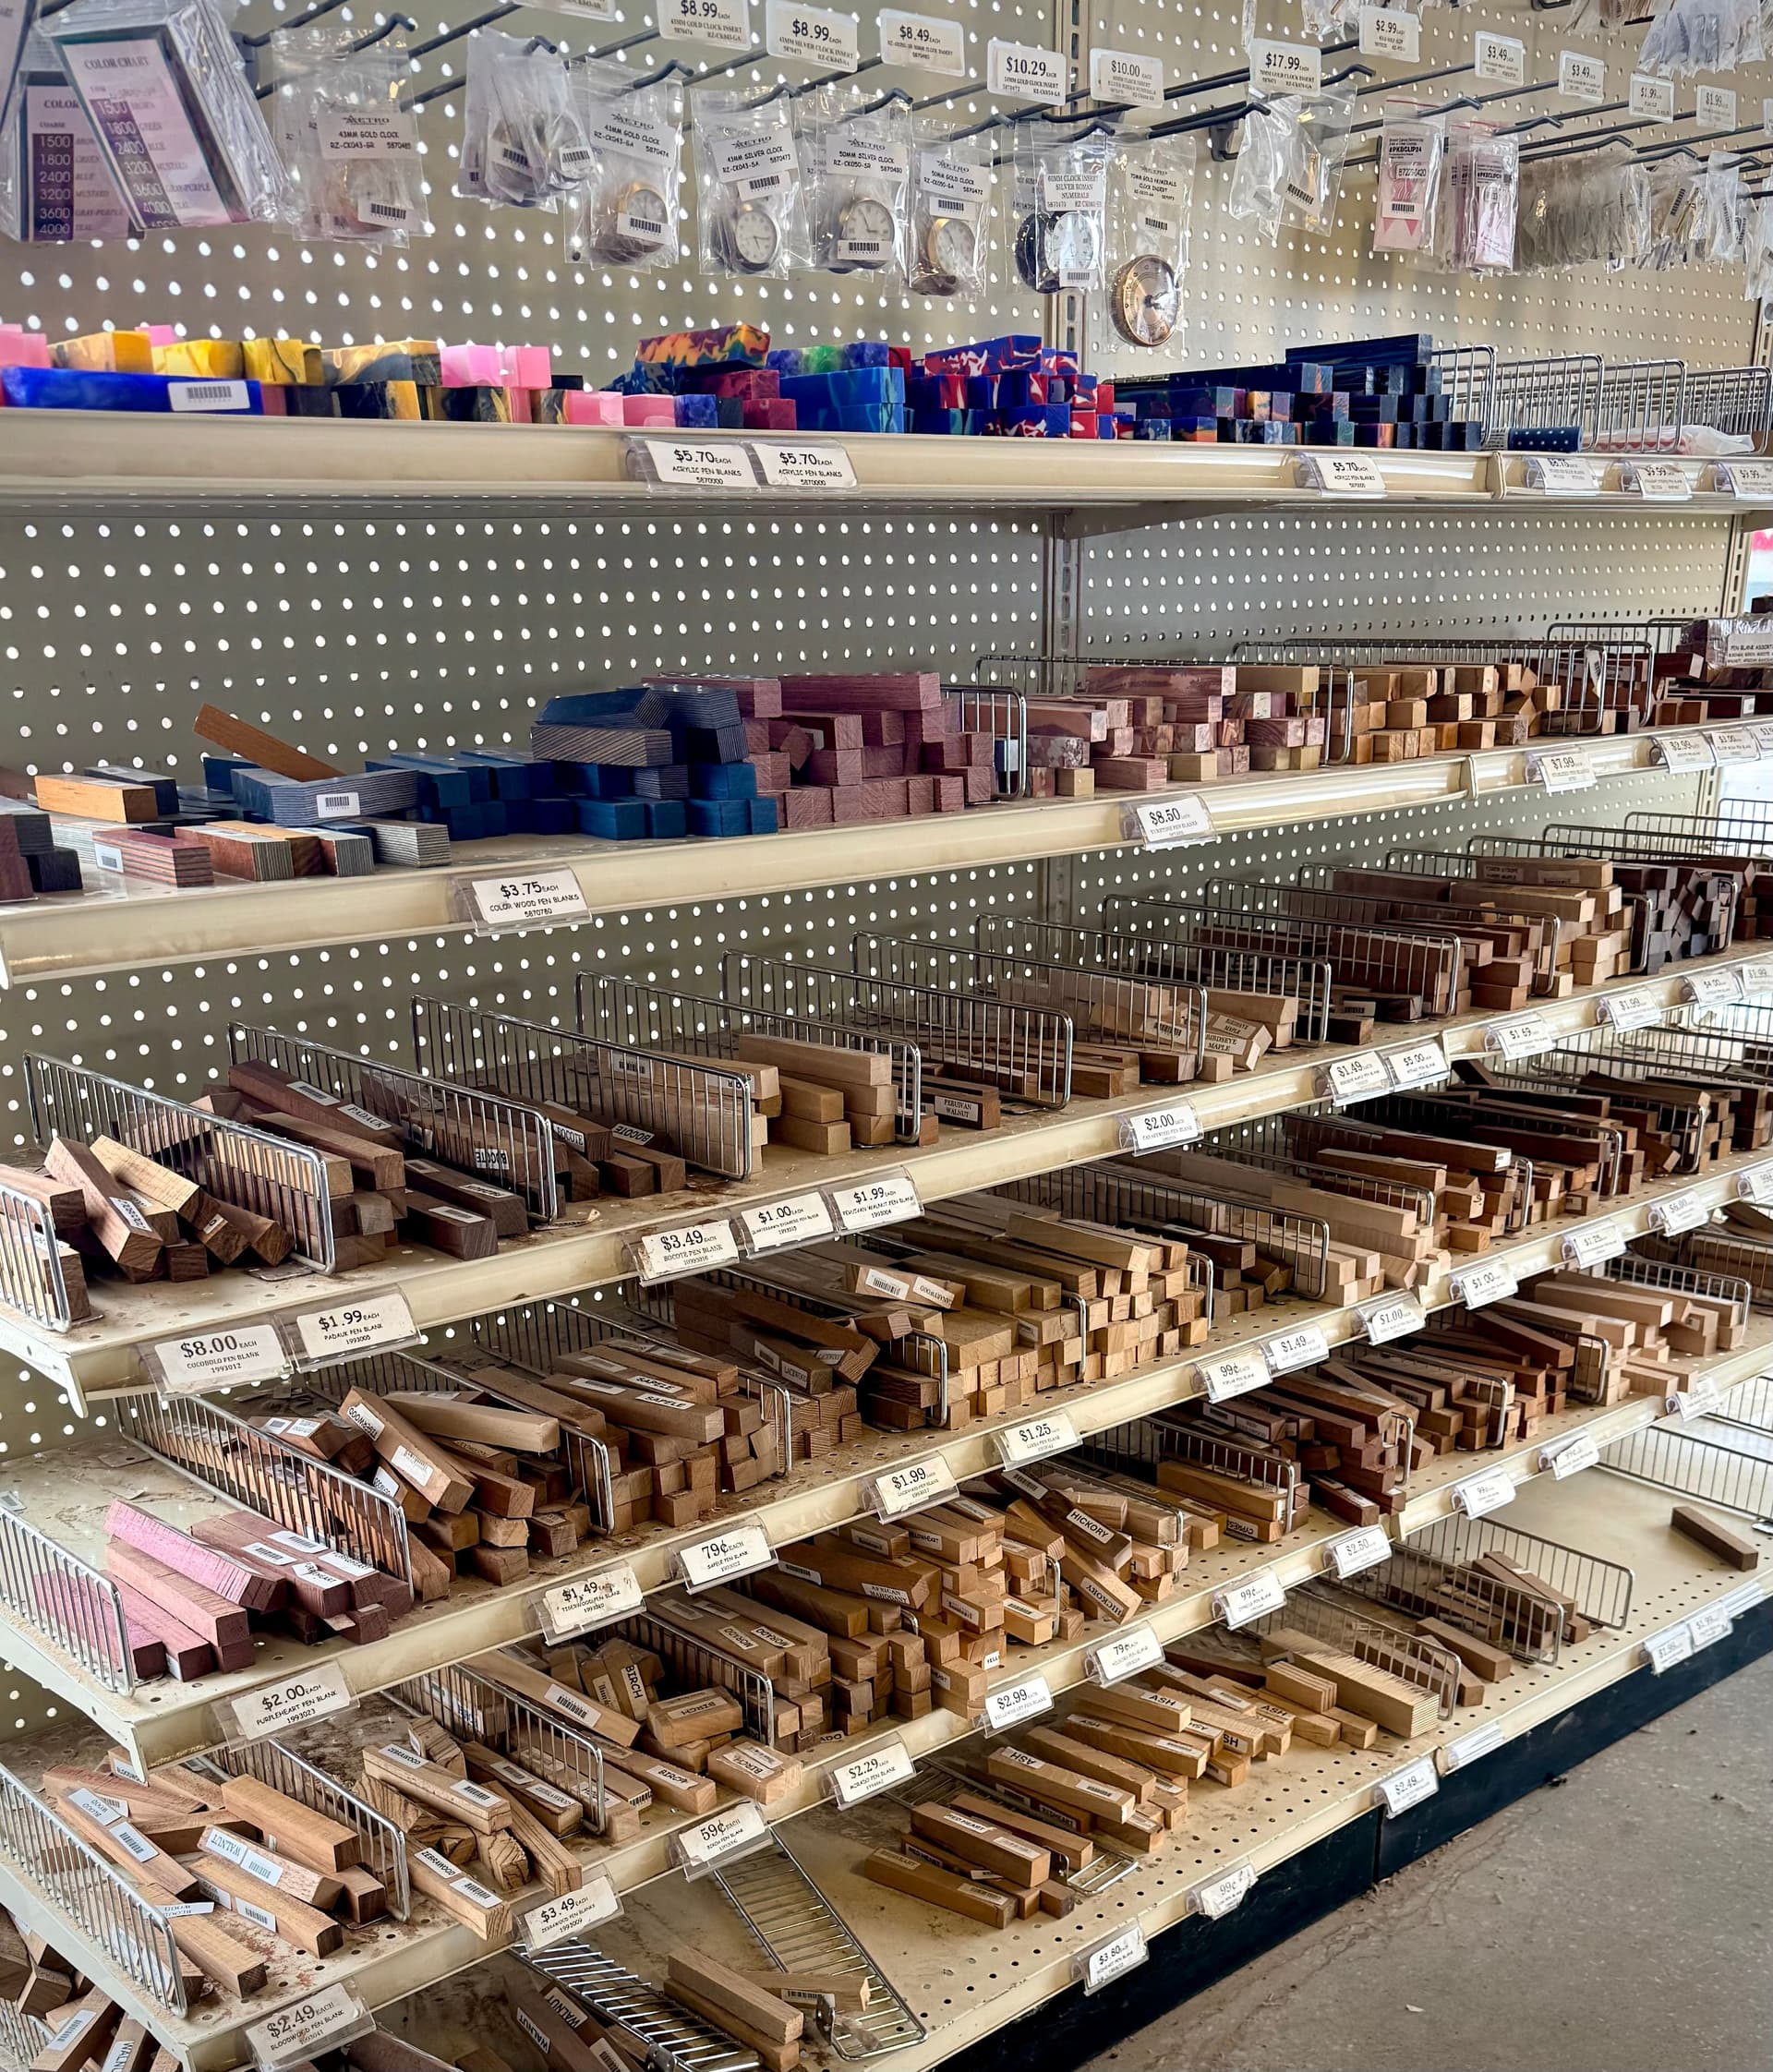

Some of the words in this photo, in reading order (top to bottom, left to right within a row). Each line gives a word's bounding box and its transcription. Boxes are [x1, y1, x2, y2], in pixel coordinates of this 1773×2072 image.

[681, 0, 718, 18] $8.99
[792, 18, 829, 41] $8.99
[899, 24, 930, 42] $8.49
[1376, 19, 1397, 35] $2.99
[1265, 53, 1300, 71] $17.99
[1488, 45, 1508, 61] $3.49
[1007, 56, 1046, 76] $10.29
[1111, 61, 1140, 78] $10.00
[1572, 65, 1590, 78] $3.49
[40, 135, 71, 148] 1500
[360, 131, 379, 139] GOLD
[380, 131, 400, 139] CLOCK
[623, 129, 641, 140] GOLD
[641, 134, 661, 146] CLOCK
[117, 141, 145, 155] 2400
[744, 149, 766, 160] SILVER
[766, 146, 783, 155] CLOCK
[40, 154, 71, 166] 1800
[858, 152, 877, 162] SILVER
[878, 156, 895, 164] CLOCK
[125, 161, 154, 175] 3200
[40, 172, 71, 183] 2400
[959, 176, 974, 186] CLOCK
[40, 188, 71, 200] 3200
[40, 208, 71, 219] 3600
[143, 200, 171, 214] 4000
[39, 223, 71, 235] 4000
[674, 449, 715, 464] $5.70
[779, 452, 817, 466] $5.70
[672, 465, 700, 475] ACRYLIC
[701, 467, 715, 476] PEN
[716, 468, 742, 476] BLANKS
[778, 468, 803, 476] ACRYLIC
[1333, 462, 1357, 472] $5.70
[1670, 740, 1692, 752] $2.99
[1551, 756, 1574, 770] $7.99
[1149, 806, 1181, 826] $8.50
[501, 880, 542, 900] $3.75
[541, 885, 560, 893] EACH
[489, 901, 513, 912] COLOR
[514, 899, 536, 910] WOOD
[537, 897, 552, 906] PEN
[553, 893, 580, 904] BLANKS
[1206, 1033, 1237, 1046] BIRDSEYE
[1208, 1042, 1231, 1053] MAPLE
[1404, 1053, 1425, 1066] $5.00
[1336, 1060, 1363, 1078] $1.49
[944, 1099, 971, 1111] PERUVIAN
[946, 1108, 971, 1120] WALNUT
[347, 1104, 390, 1129] PADAUK
[1144, 1114, 1175, 1131] $2.00
[557, 1126, 585, 1148] BOCOTE
[615, 1123, 653, 1145] BOCOTE
[853, 1186, 885, 1204] $1.99
[757, 1206, 792, 1224] $1.00
[868, 1201, 888, 1212] WALNUT
[660, 1229, 704, 1253] $3.49
[663, 1249, 689, 1263] BOCOTE
[688, 1247, 702, 1259] PEN
[703, 1243, 724, 1255] BLANK
[1471, 1272, 1495, 1290] $1.00
[319, 1309, 363, 1331] $1.99
[363, 1311, 380, 1321] EACH
[1378, 1307, 1405, 1326] $1.00
[324, 1329, 349, 1342] PADAUK
[349, 1327, 363, 1337] PEN
[363, 1322, 383, 1333] BLANK
[180, 1334, 238, 1360] $8.00
[239, 1340, 258, 1350] EACH
[1280, 1334, 1308, 1354] $1.49
[186, 1356, 223, 1370] COCOBOLO
[223, 1354, 237, 1365] PEN
[237, 1351, 260, 1362] BLANK
[1220, 1362, 1240, 1378] 99¢
[634, 1375, 675, 1392] SAPELE
[645, 1394, 687, 1408] SAPELE
[347, 1404, 380, 1441] TIGERWOOD
[1019, 1422, 1052, 1442] $1.25
[892, 1466, 927, 1490] $1.99
[1069, 1510, 1109, 1540] HICKORY
[701, 1540, 729, 1560] 79¢
[729, 1540, 745, 1552] EACH
[1345, 1539, 1369, 1557] $2.50
[724, 1556, 734, 1565] PEN
[1086, 1583, 1124, 1617] HICKORY
[1239, 1584, 1257, 1598] 99¢
[724, 1626, 754, 1650] MORADO
[756, 1627, 787, 1647] MORADO
[625, 1664, 644, 1699] BIRCH
[262, 1683, 306, 1711] $2.00
[306, 1684, 322, 1695] EACH
[996, 1688, 1029, 1711] $2.99
[1149, 1694, 1177, 1707] ASH
[256, 1703, 301, 1726] PURPLEHEART
[301, 1698, 316, 1708] PEN
[316, 1690, 338, 1703] BLANK
[681, 1699, 718, 1717] BIRCH
[1260, 1705, 1289, 1718] ASH
[1080, 1718, 1102, 1729] ASH
[1223, 1733, 1239, 1748] SH
[386, 1746, 422, 1765] ZEBRAWOOD
[732, 1754, 765, 1775] BIRCH
[1010, 1751, 1035, 1766] ASH
[657, 1768, 689, 1784] BIRCH
[848, 1757, 879, 1780] $2.29
[1393, 1775, 1417, 1796] $2.49
[534, 1786, 573, 1806] ZEBRAWOOD
[700, 1819, 727, 1842] 59¢
[212, 1830, 243, 1858] WALNUT
[706, 1838, 721, 1850] BIRCH
[720, 1835, 730, 1844] PEN
[421, 1849, 455, 1877] ZEBRAWOOD
[1219, 1880, 1237, 1897] 99¢
[541, 1897, 575, 1923] $3.49
[1099, 1945, 1121, 1966] $3.80
[547, 1987, 584, 2028] WALNUT
[266, 2004, 315, 2039] $2.49
[315, 2001, 335, 2016] EACH
[310, 2019, 324, 2030] PEN
[324, 2008, 345, 2023] BLANK
[517, 2013, 549, 2052] WALNUT
